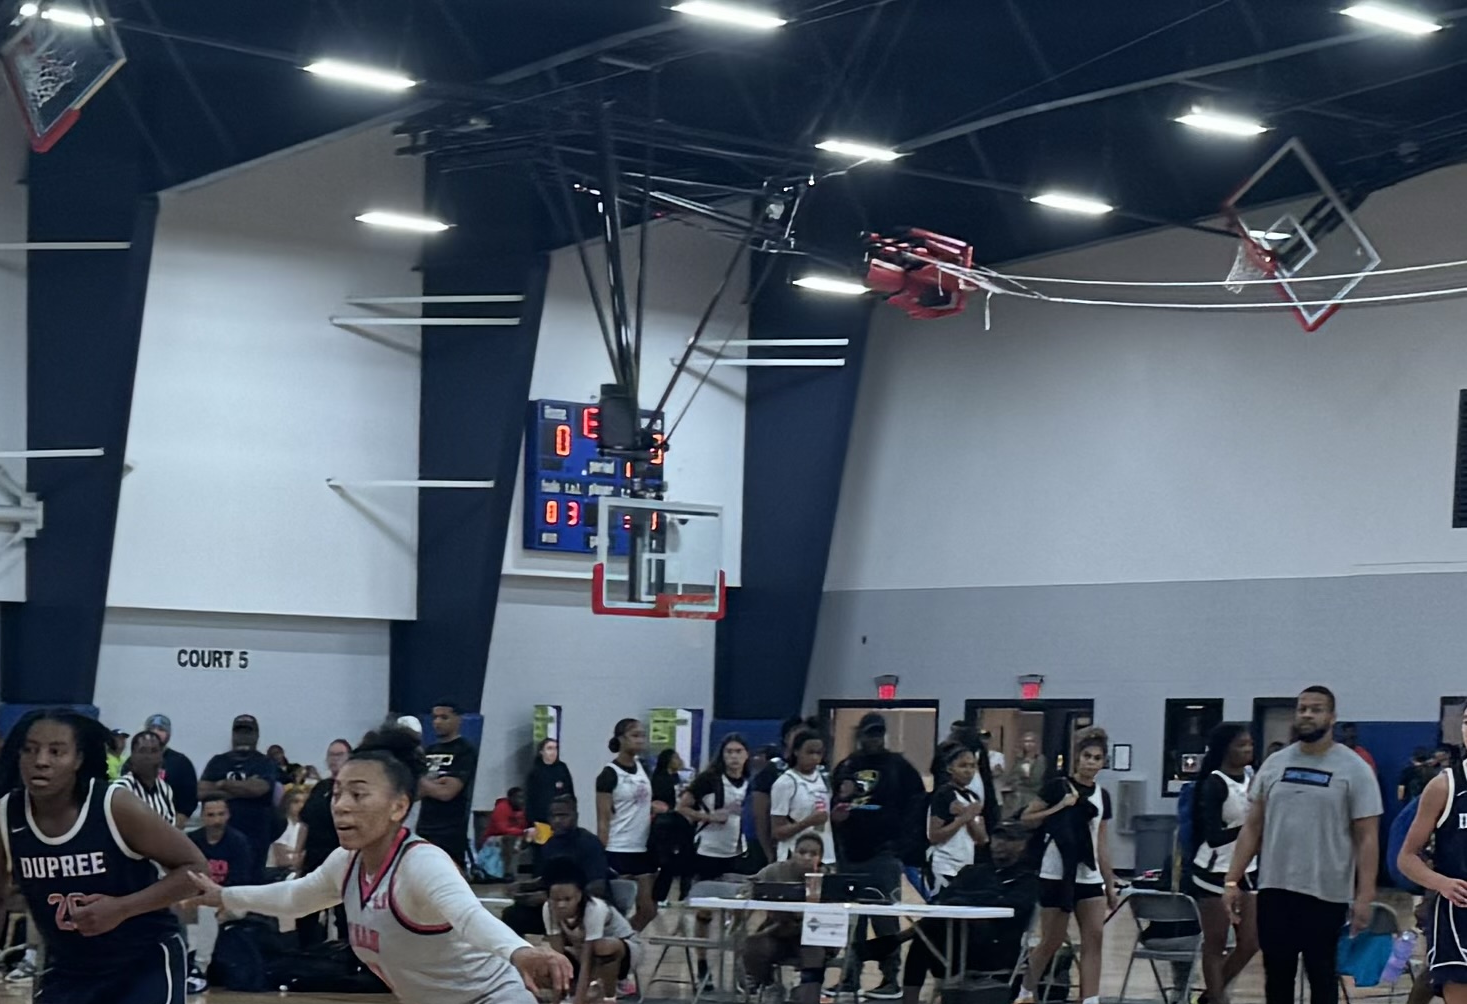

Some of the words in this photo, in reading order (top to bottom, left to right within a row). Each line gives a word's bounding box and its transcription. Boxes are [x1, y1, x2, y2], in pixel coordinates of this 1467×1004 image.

[176, 648, 235, 669] COURT
[238, 650, 249, 670] 5
[19, 851, 107, 879] DUPREE
